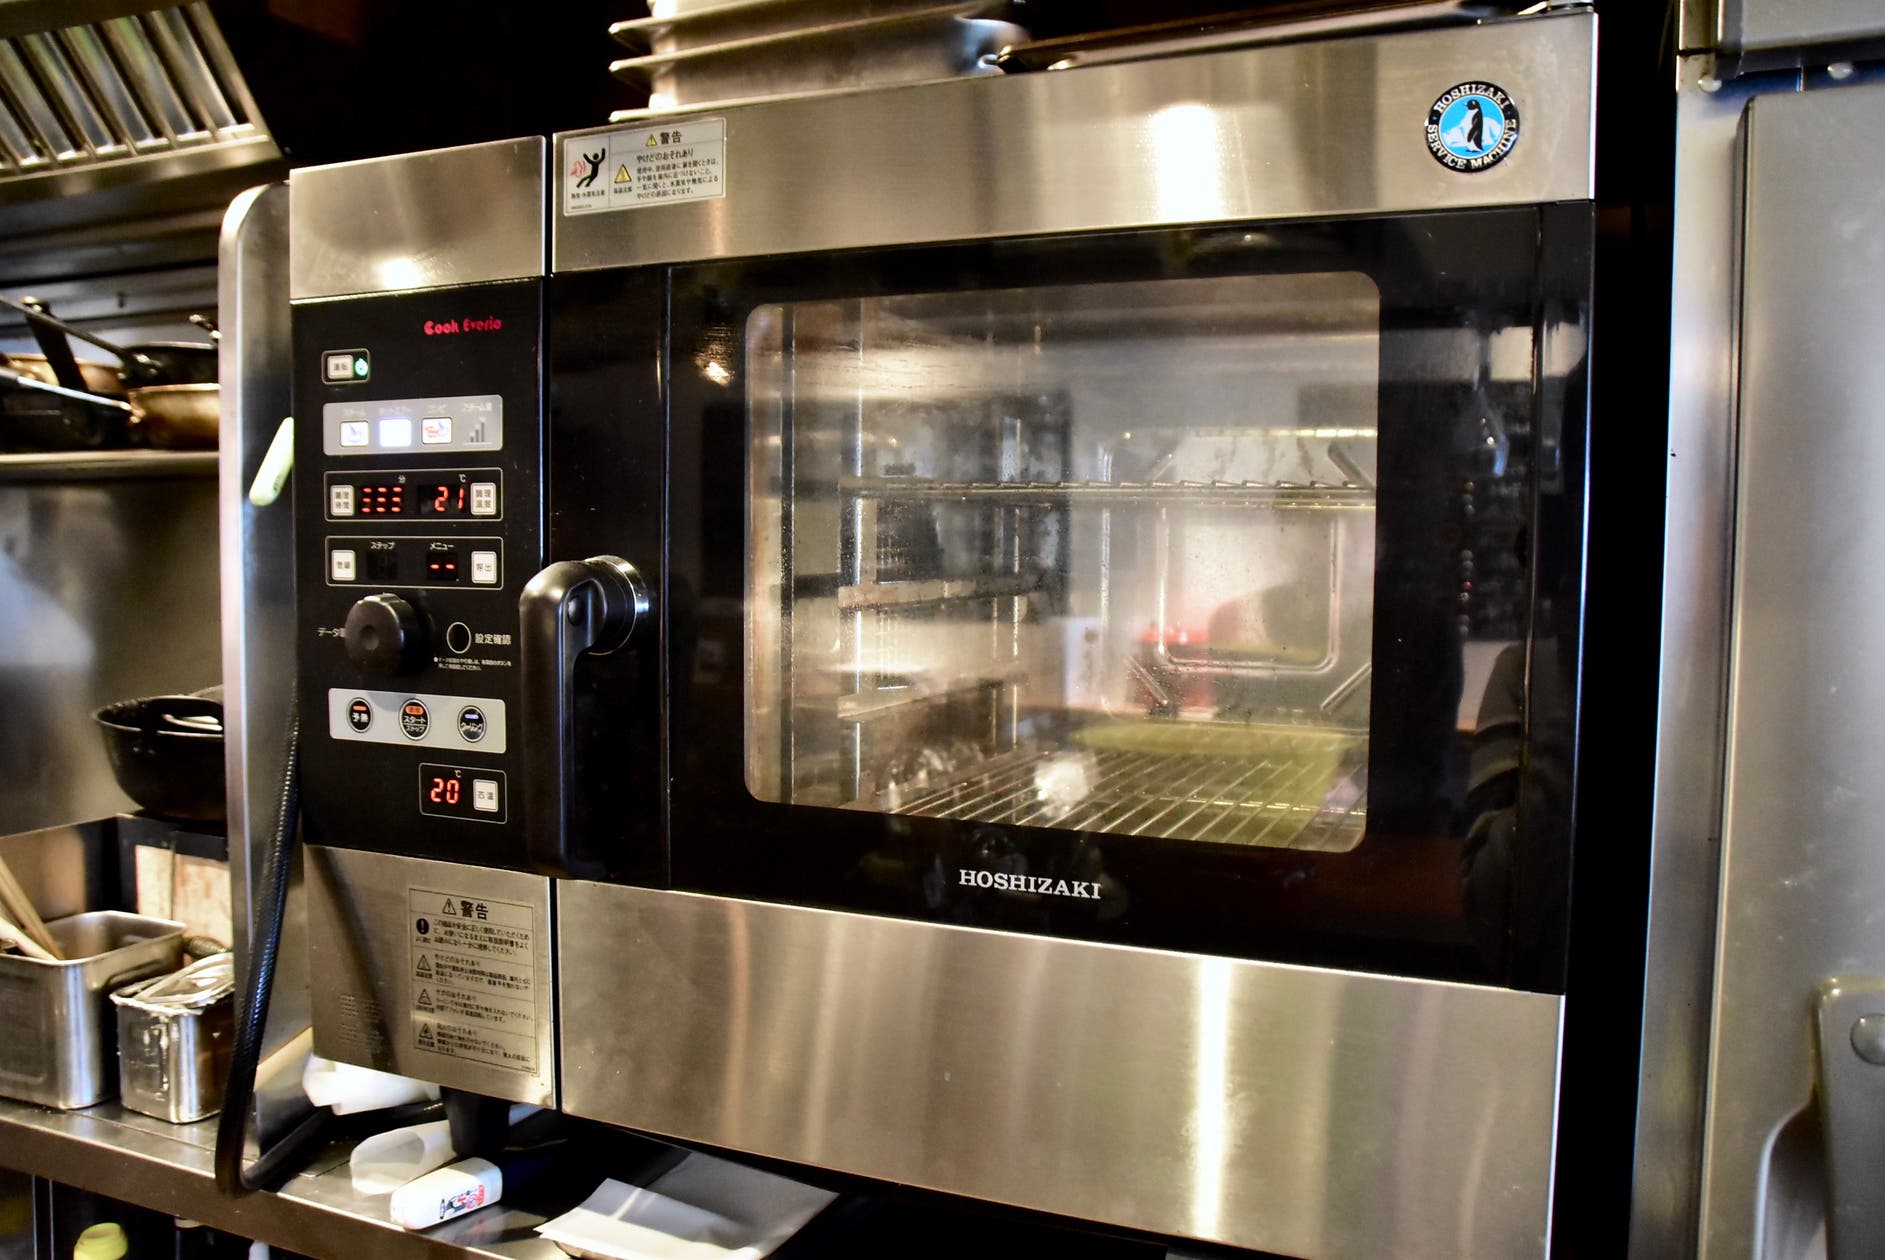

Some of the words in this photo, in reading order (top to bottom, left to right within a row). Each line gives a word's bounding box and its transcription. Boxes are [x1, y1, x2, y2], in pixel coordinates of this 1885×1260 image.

[1433, 83, 1509, 113] HOSHIZAKI
[660, 129, 682, 145] 警告
[1427, 123, 1467, 170] SERVICE
[1471, 118, 1517, 169] MACHINE
[424, 320, 459, 336] Cook
[435, 486, 465, 513] 21
[370, 541, 395, 550] ステップ
[429, 542, 455, 551] メニュー
[475, 632, 512, 646] 設定確認
[403, 716, 427, 724] スタート
[430, 777, 460, 804] 20
[958, 868, 1102, 900] HOSHIZAKI
[460, 900, 489, 920] 警告
